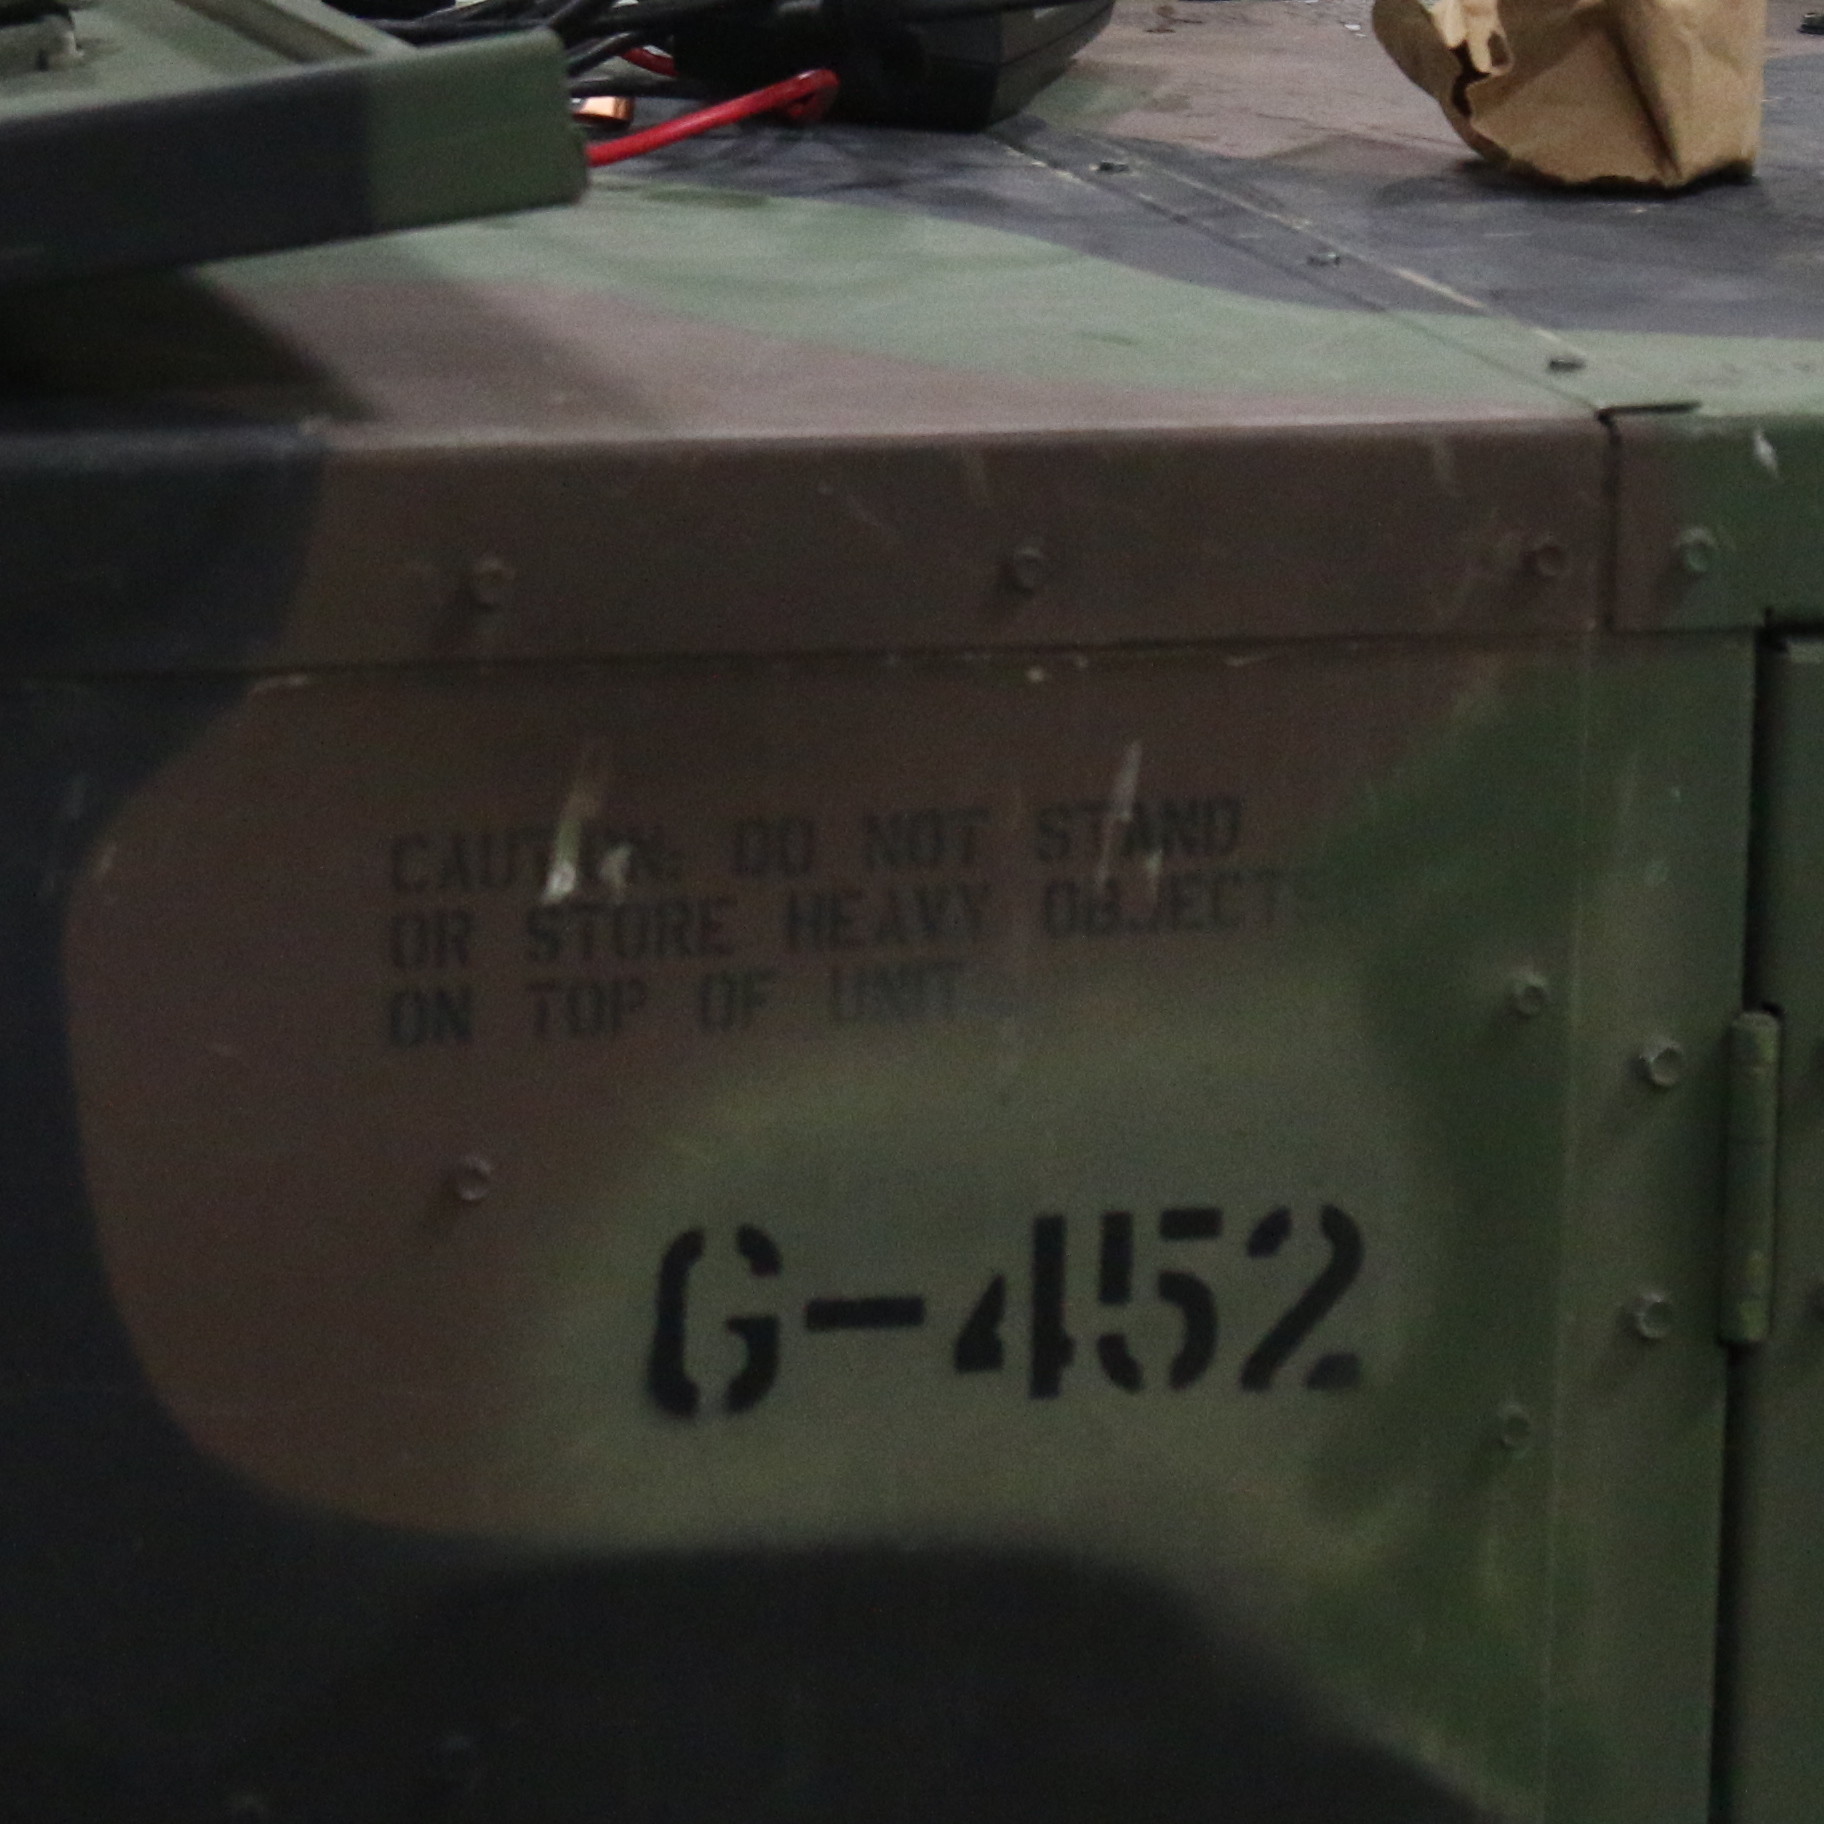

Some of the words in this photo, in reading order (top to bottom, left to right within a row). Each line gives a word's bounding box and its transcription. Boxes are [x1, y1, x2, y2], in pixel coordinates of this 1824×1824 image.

[389, 822, 685, 894] CAUTON:
[729, 815, 817, 879] DO
[862, 806, 993, 873] NOT
[1034, 793, 1245, 866] STAND
[389, 908, 474, 972] OR
[523, 892, 739, 965] STORE
[786, 879, 995, 953] HEAVY
[388, 985, 475, 1048] ON
[522, 977, 650, 1043] TOP
[698, 969, 774, 1034] OF
[647, 1202, 1366, 1420] G-452
